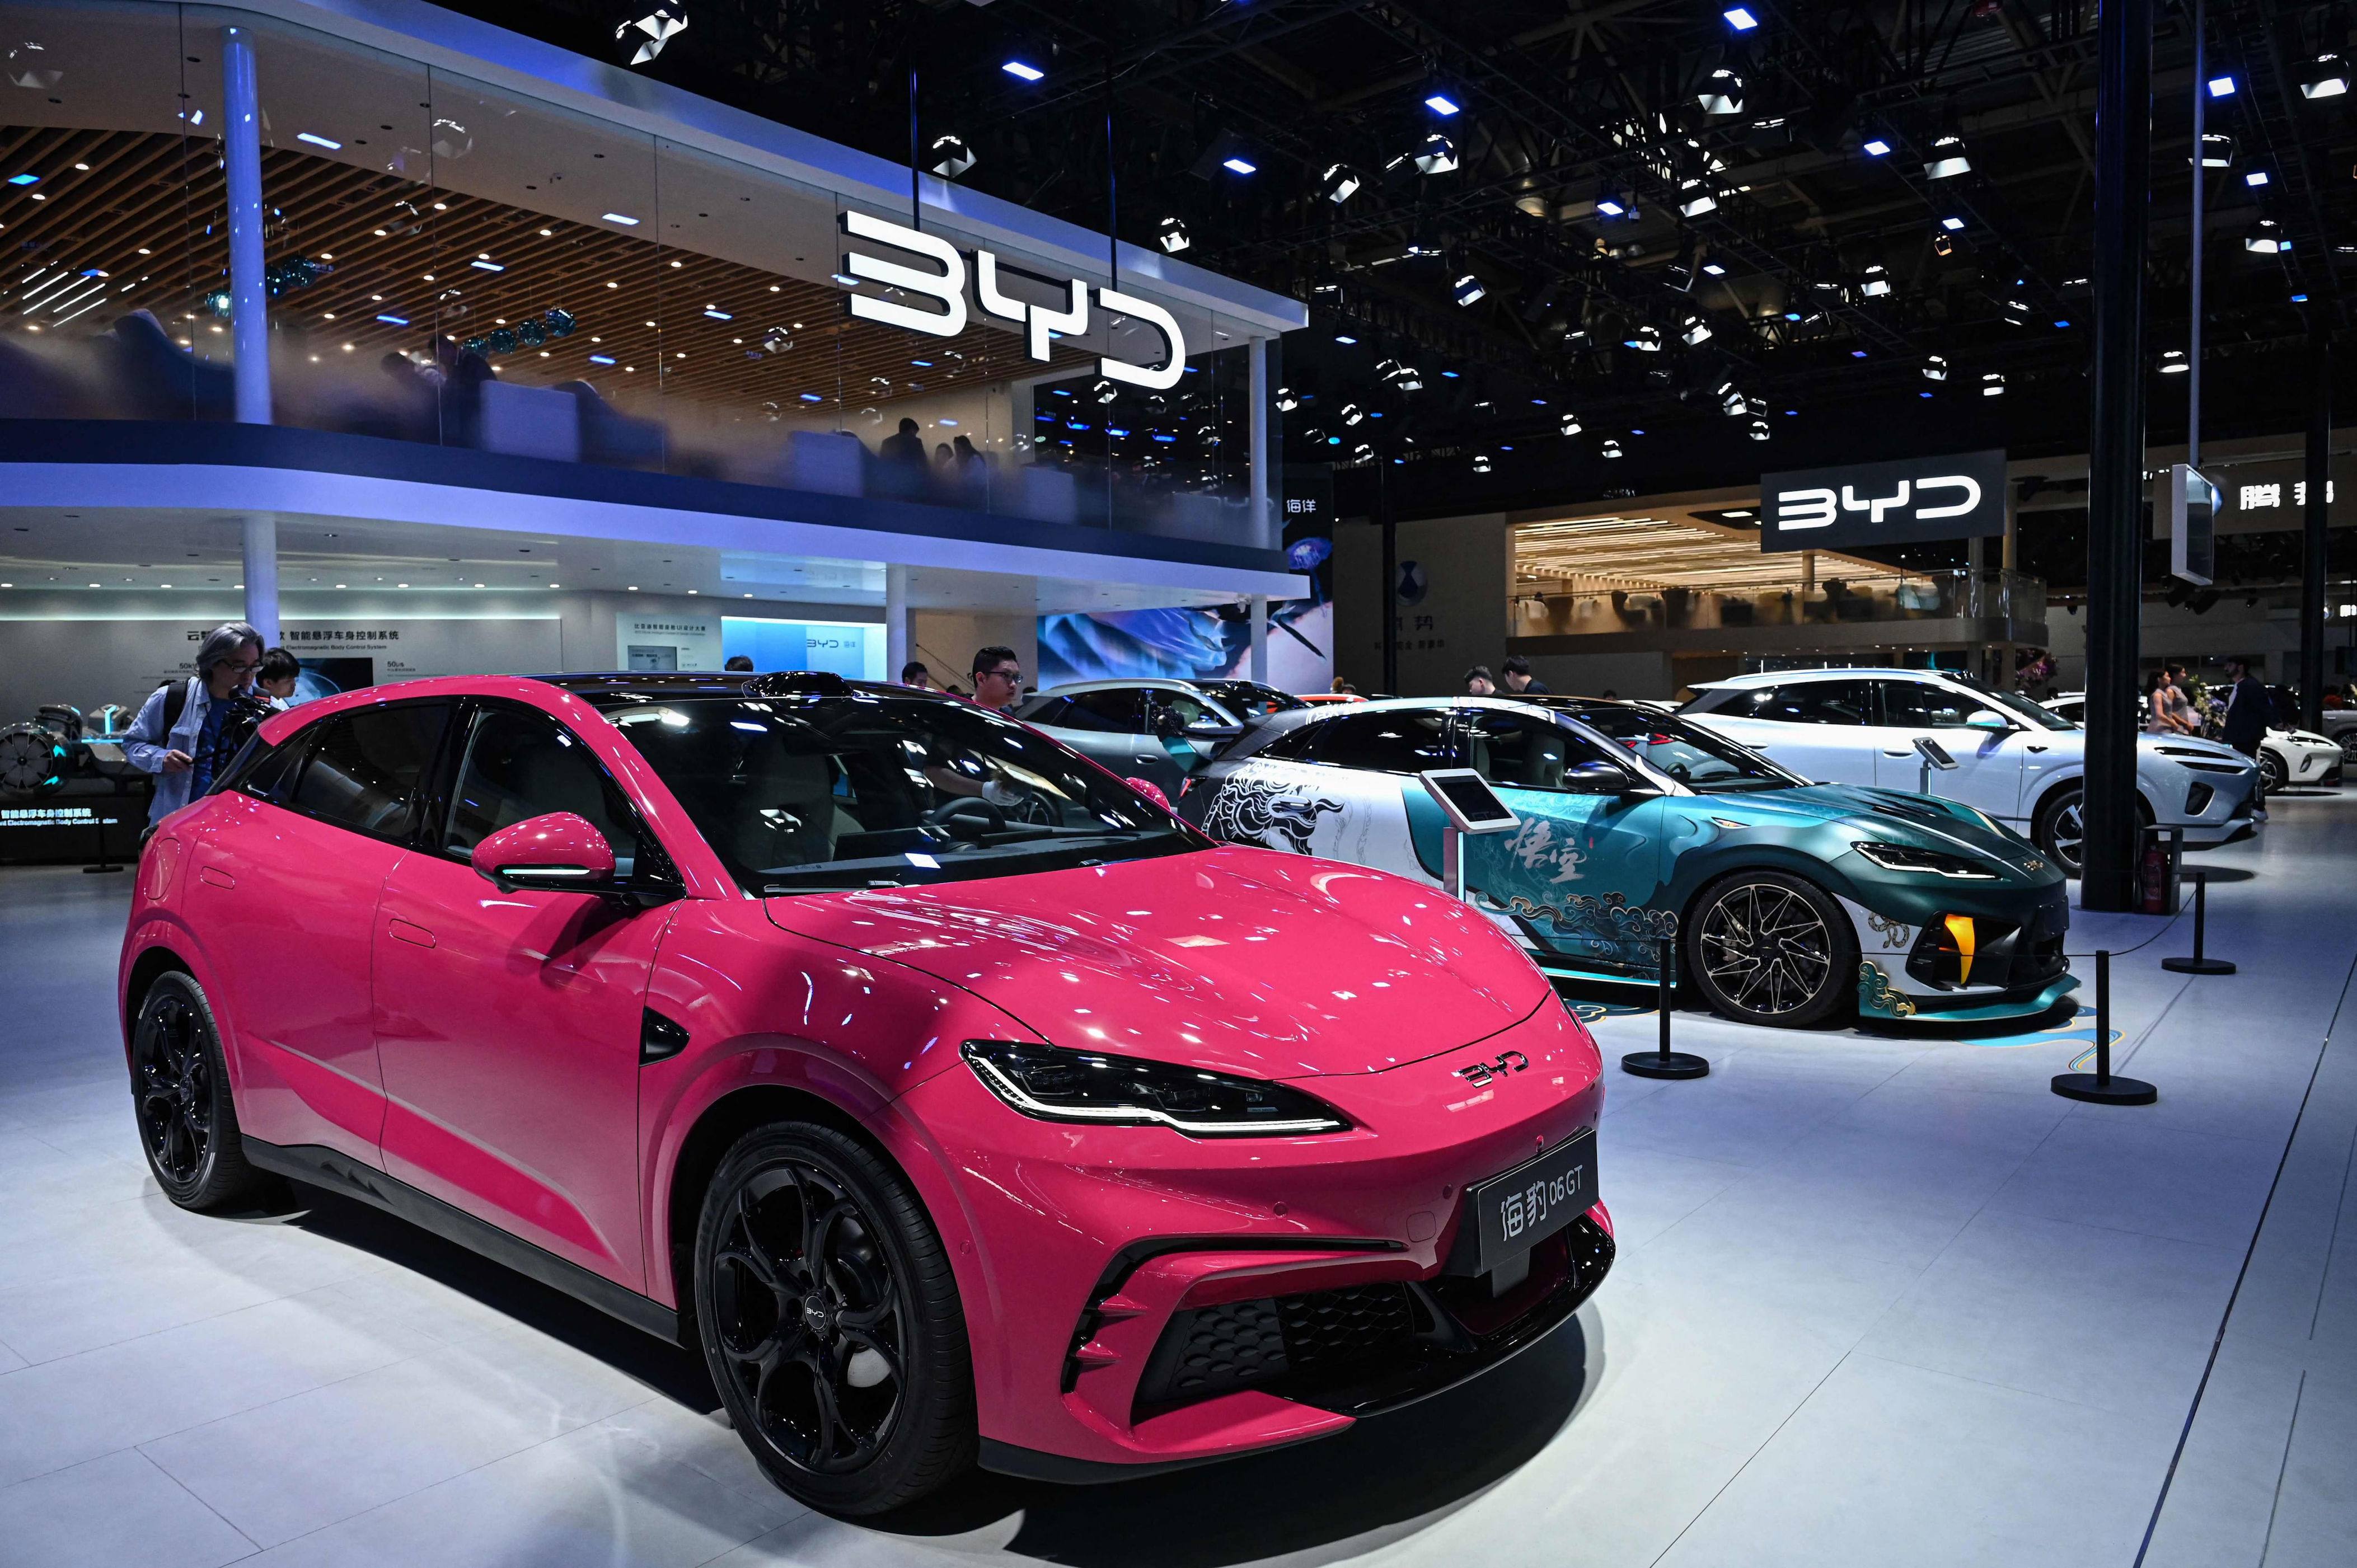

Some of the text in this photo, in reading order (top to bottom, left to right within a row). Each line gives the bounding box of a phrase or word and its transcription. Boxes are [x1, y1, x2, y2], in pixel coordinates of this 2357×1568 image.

[841, 210, 1186, 390] BYD
[1287, 499, 1316, 513] 海洋
[1778, 475, 1981, 531] BYD
[290, 631, 399, 640] 智能悬浮车身控制系统
[807, 639, 839, 648] BYD
[1, 808, 92, 819] 智能悬浮车身控制系统
[1456, 1050, 1529, 1088] BYD
[807, 1307, 824, 1318] BYD
